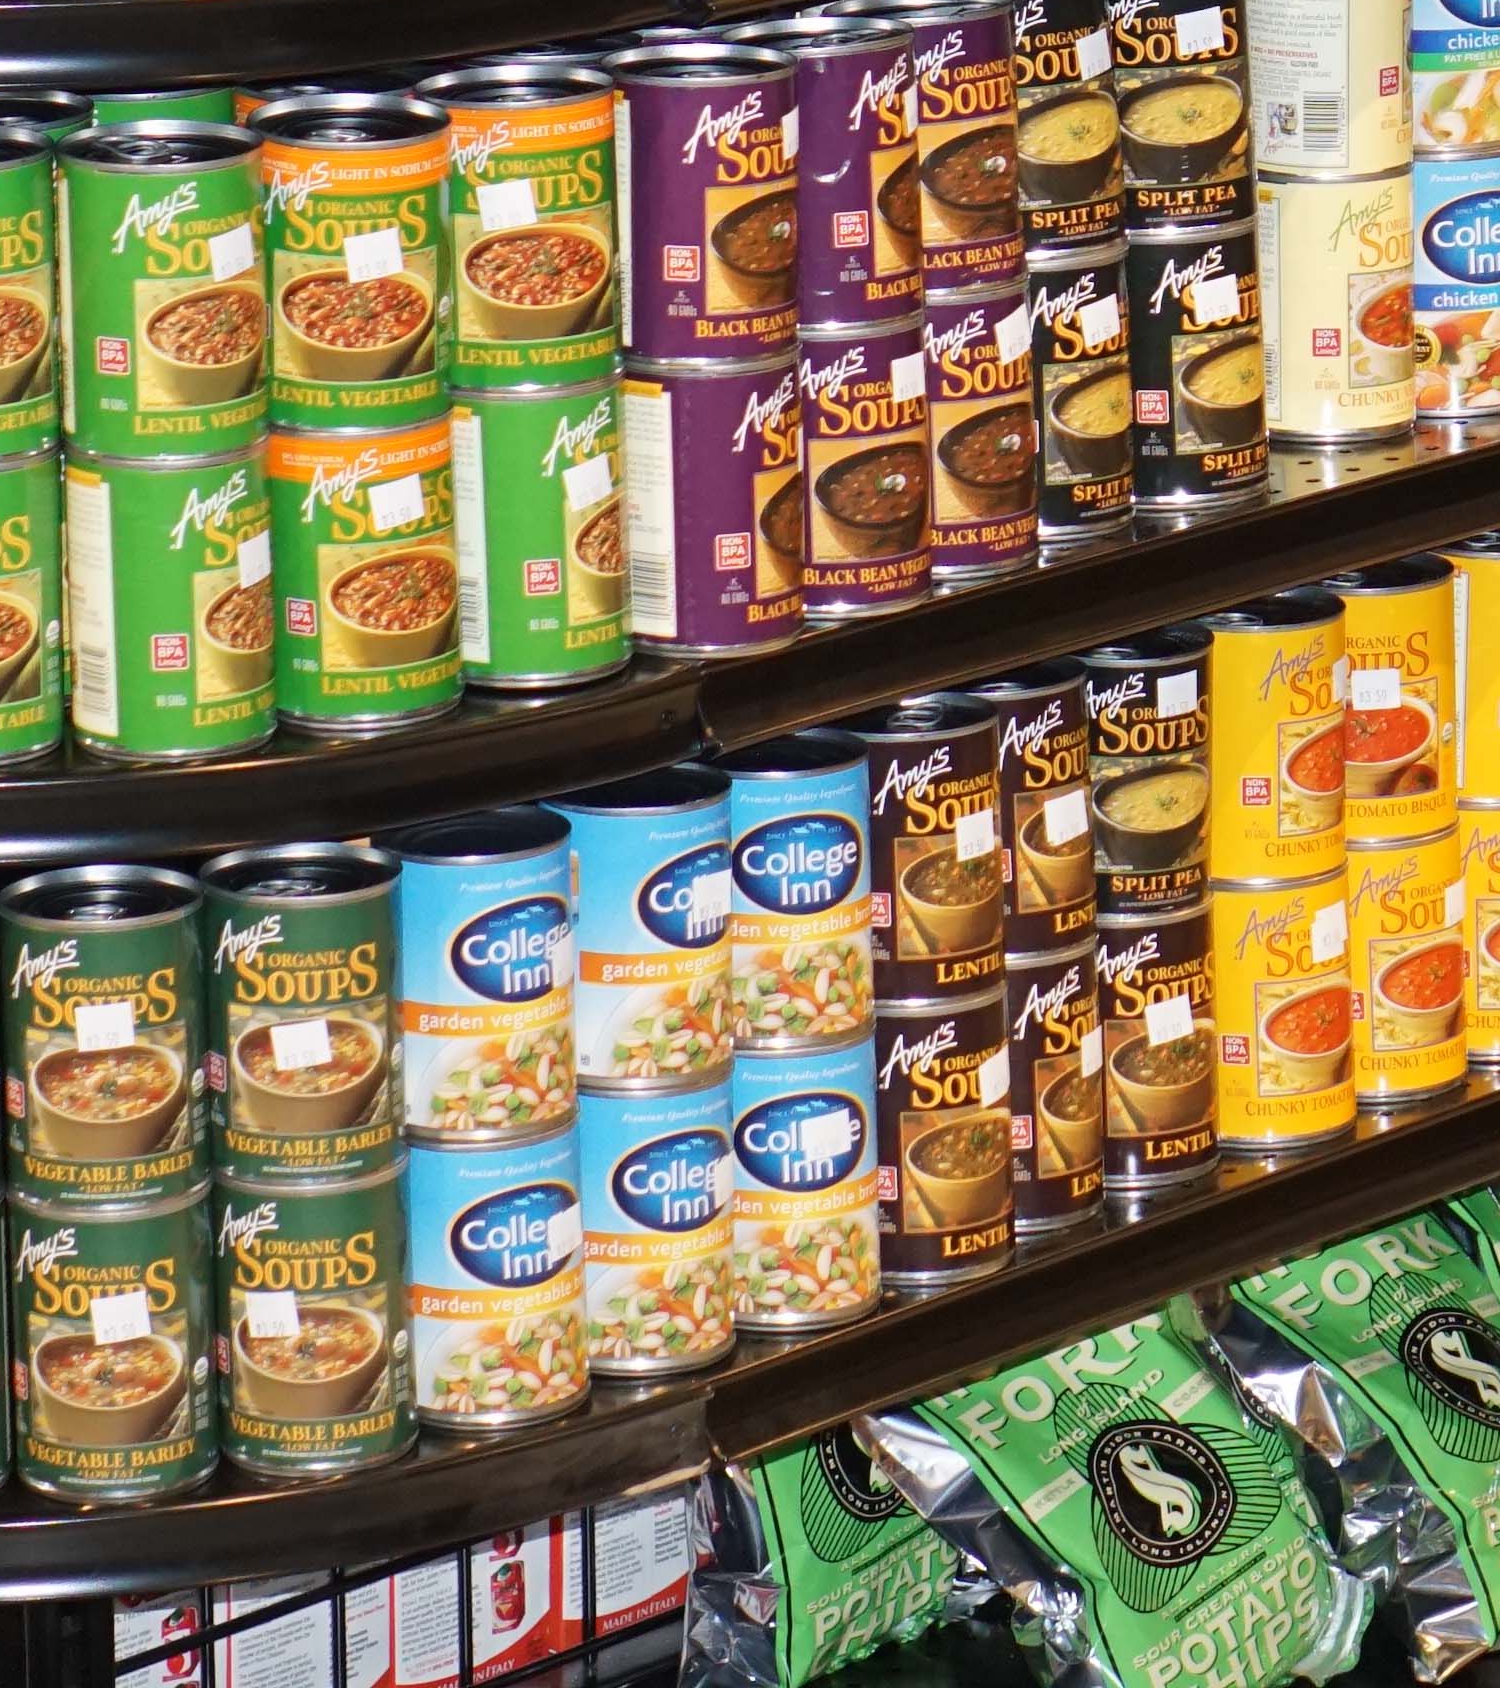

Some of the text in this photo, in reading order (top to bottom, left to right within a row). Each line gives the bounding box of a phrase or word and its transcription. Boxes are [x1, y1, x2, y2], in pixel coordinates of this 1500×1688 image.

[684, 91, 763, 163] Amy's
[1137, 185, 1237, 208] SPLIT PEA
[667, 246, 694, 261] NON-
[668, 257, 695, 270] BPA
[1433, 290, 1496, 309] chicken
[696, 313, 783, 340] BLACK BEAN
[874, 745, 949, 814] Amy's
[1348, 791, 1448, 819] TOMATO BISQUE
[741, 841, 857, 877] College
[780, 875, 833, 907] Inn
[214, 915, 283, 975] Amy's
[268, 950, 347, 968] ORGANIC
[237, 943, 378, 1007] SOUPS
[418, 998, 571, 1034] garden vegetable
[1246, 1098, 1307, 1116] CHUNKY
[226, 1124, 392, 1154] VEGETABLE BARLEY
[942, 1228, 1010, 1257] LENTIL
[602, 1595, 678, 1631] MADE IN ITALY
